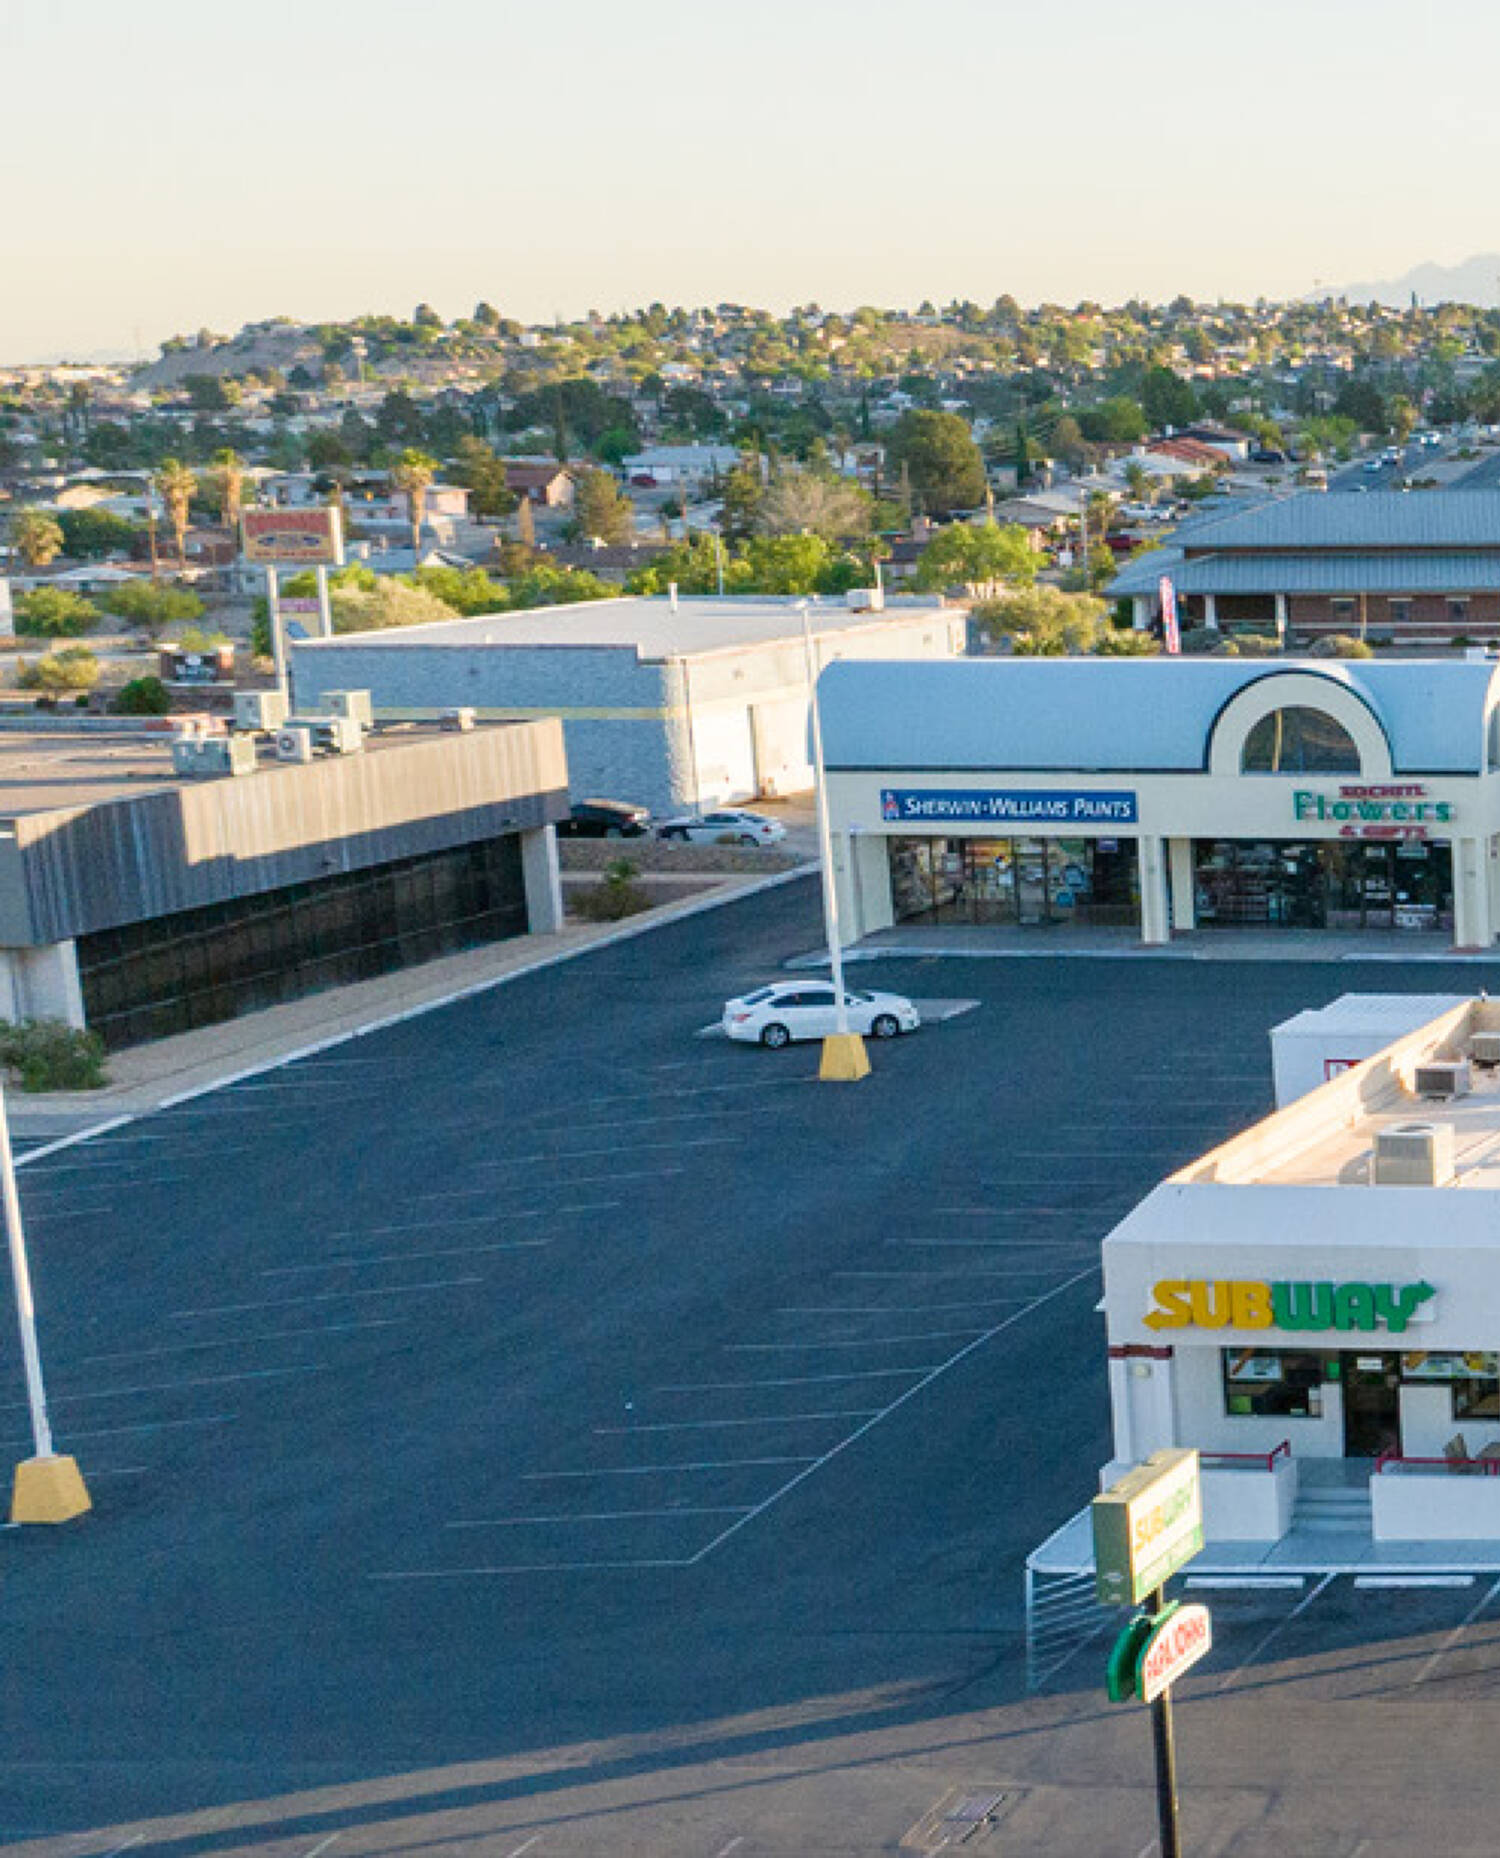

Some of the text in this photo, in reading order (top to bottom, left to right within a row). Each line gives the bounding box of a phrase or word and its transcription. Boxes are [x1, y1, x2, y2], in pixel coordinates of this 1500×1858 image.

[1073, 797, 1132, 818] PAINTS
[1292, 789, 1455, 822] Flowers
[1141, 1279, 1437, 1334] SUBWAY
